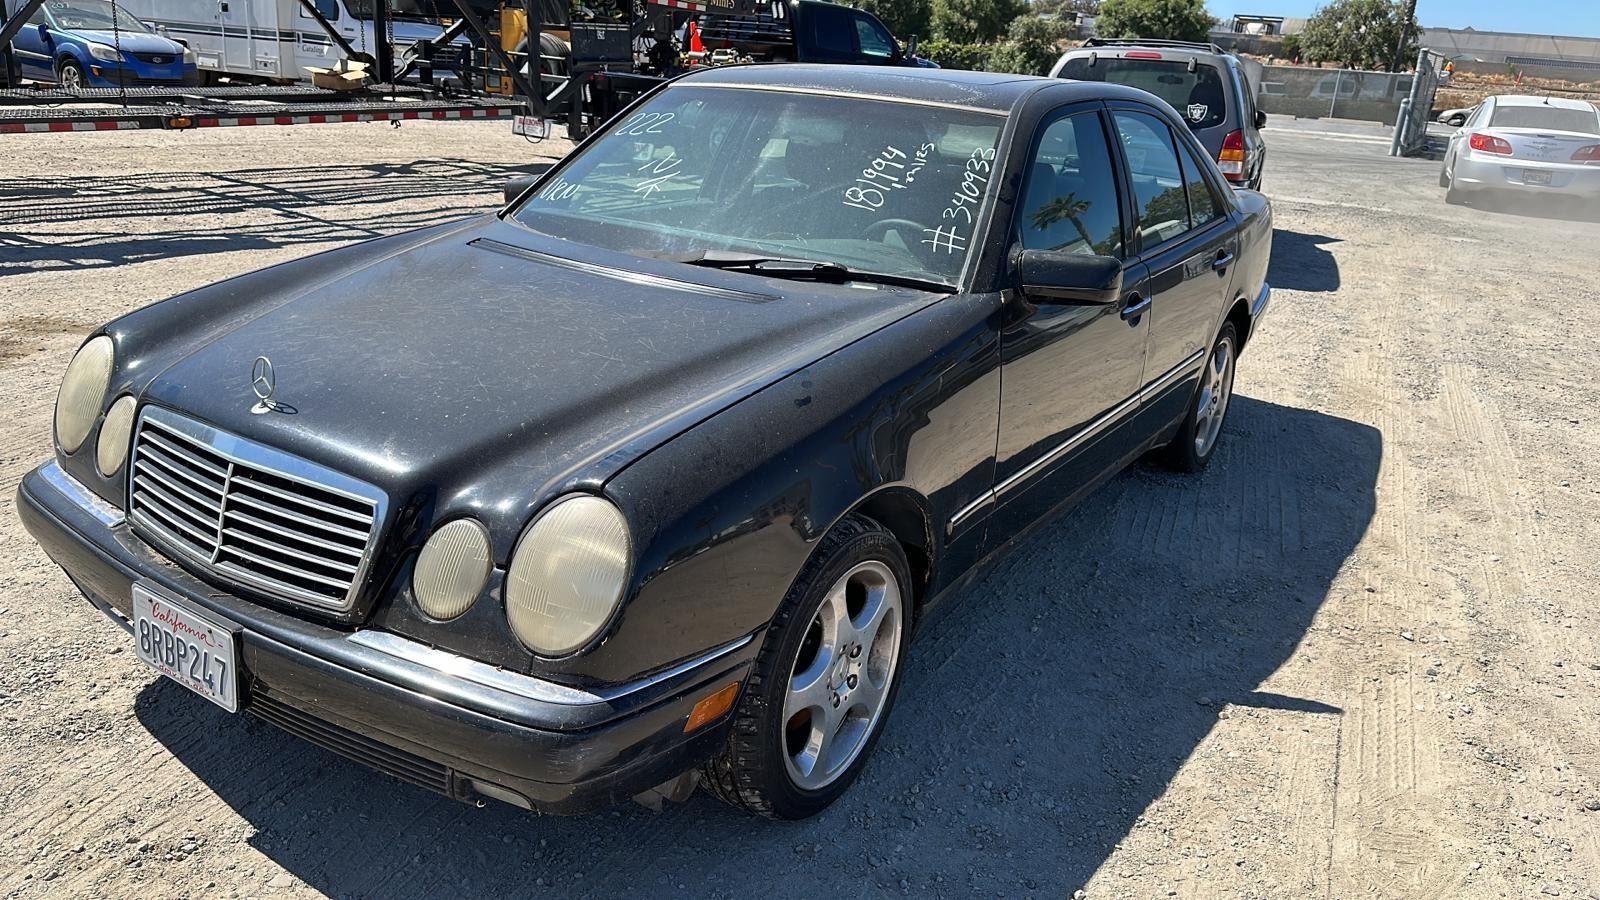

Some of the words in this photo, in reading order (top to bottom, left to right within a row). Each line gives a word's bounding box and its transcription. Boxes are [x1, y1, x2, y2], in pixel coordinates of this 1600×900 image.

[614, 112, 675, 136] 222
[920, 147, 996, 254] #340933
[151, 602, 214, 648] California
[139, 617, 226, 696] 8RBP247
